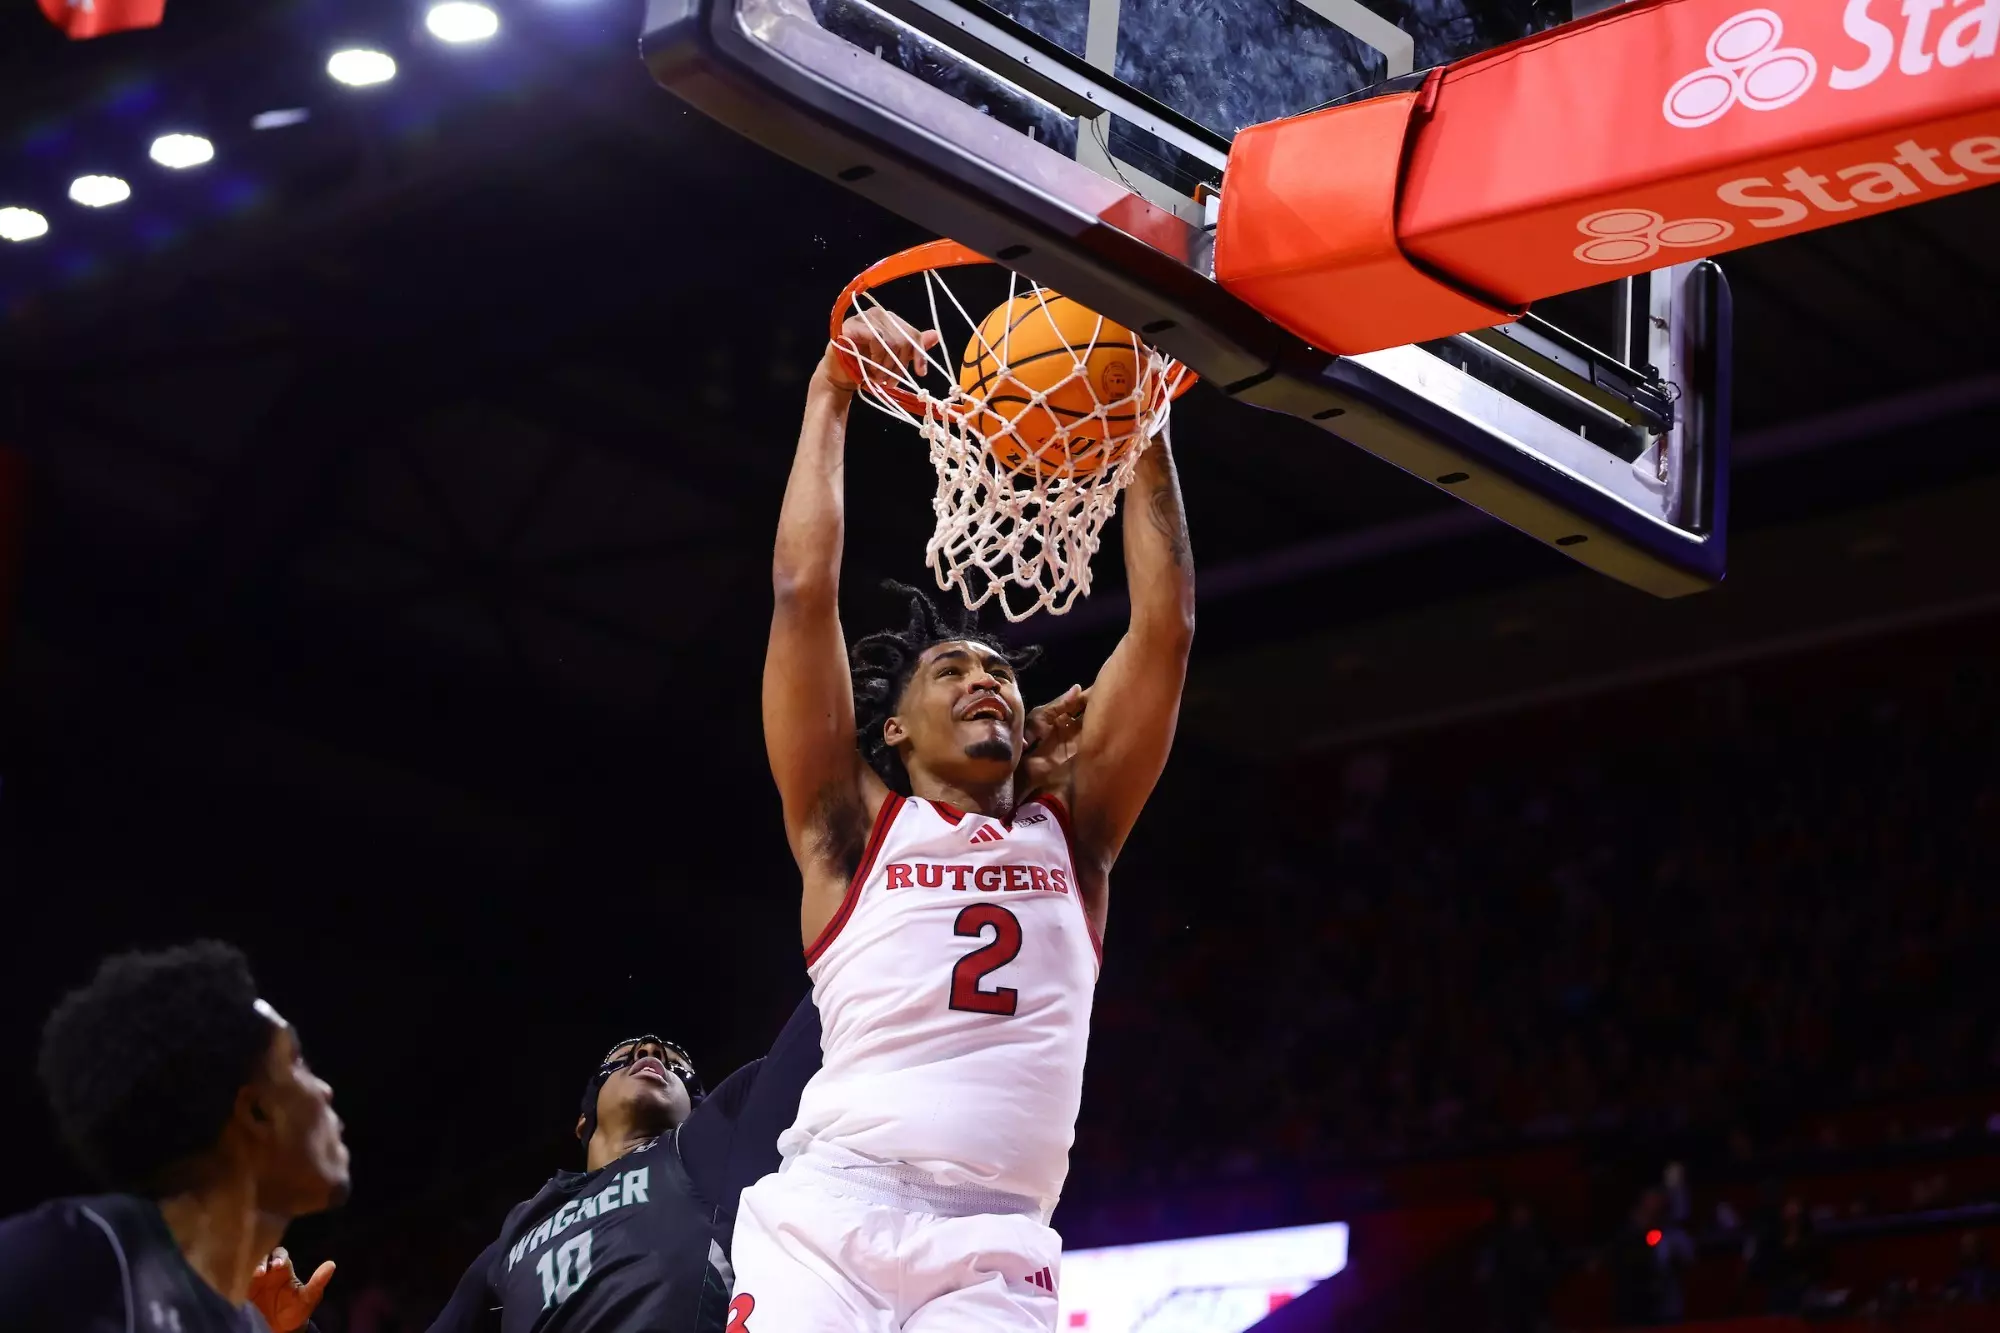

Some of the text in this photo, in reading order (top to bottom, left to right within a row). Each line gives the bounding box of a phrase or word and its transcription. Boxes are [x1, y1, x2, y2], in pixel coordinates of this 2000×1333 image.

[1717, 136, 2000, 228] State
[886, 863, 1069, 895] RUTGERS
[948, 902, 1023, 1017] 2
[508, 1166, 650, 1273] WAGNER
[535, 1228, 594, 1312] 10
